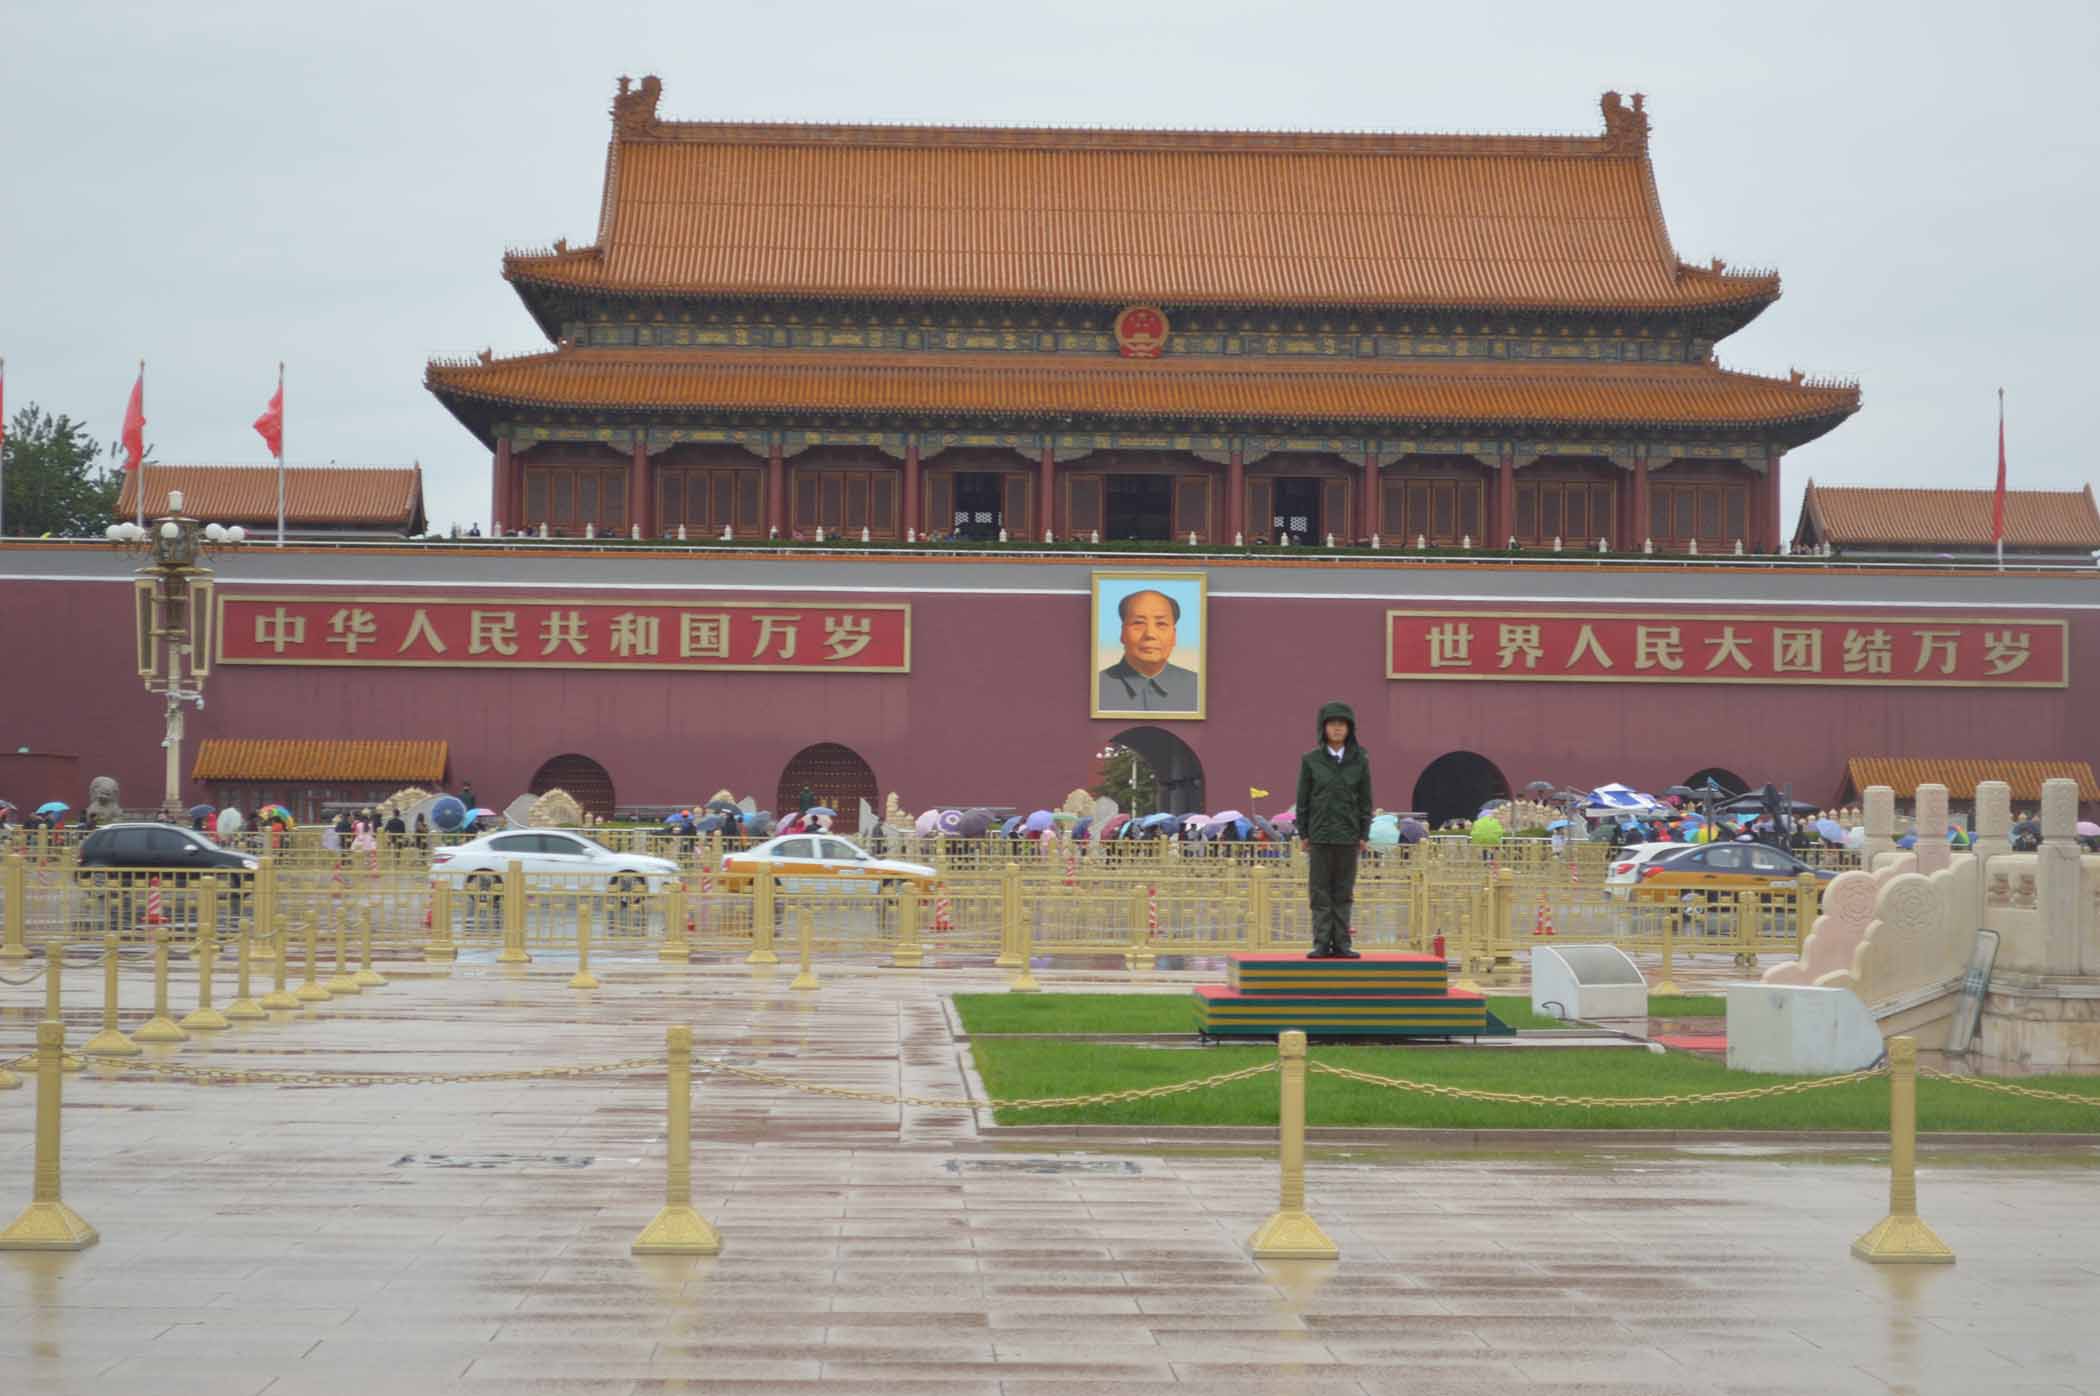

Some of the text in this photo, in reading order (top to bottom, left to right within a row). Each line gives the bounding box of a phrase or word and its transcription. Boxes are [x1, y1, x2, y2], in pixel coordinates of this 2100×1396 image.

[255, 607, 873, 660] 中华人民共和国万岁
[1425, 623, 2032, 675] 世界人民大团结万岁
